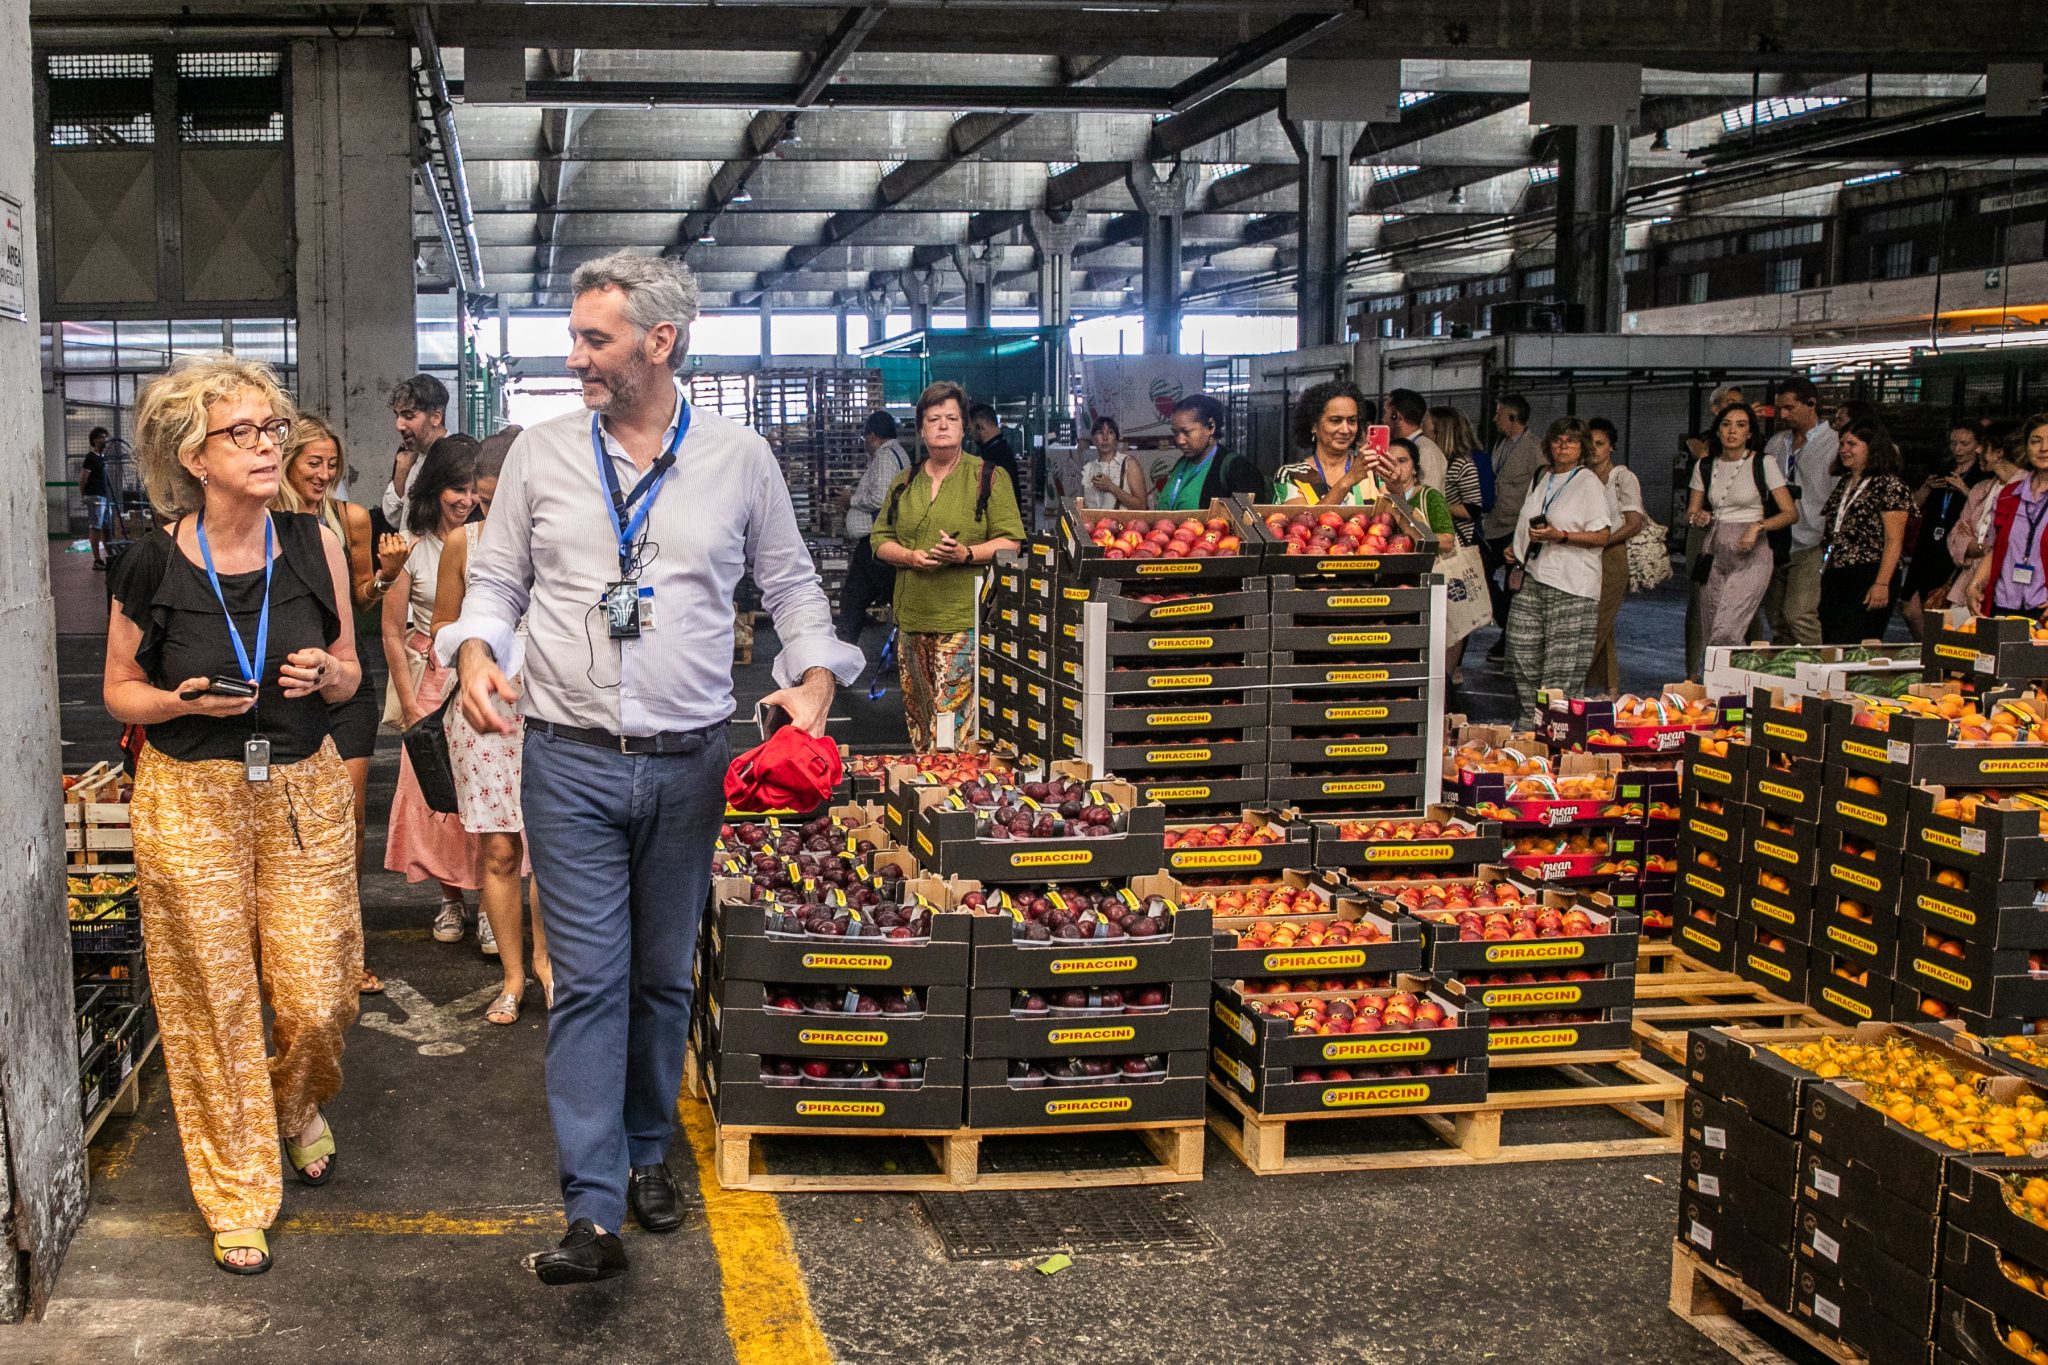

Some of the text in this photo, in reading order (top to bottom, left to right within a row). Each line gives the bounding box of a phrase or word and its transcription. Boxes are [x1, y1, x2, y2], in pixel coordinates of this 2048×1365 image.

[7, 244, 21, 268] AREA
[1159, 604, 1210, 614] PIRACCINI
[1158, 639, 1210, 647] PIRACCINI
[1940, 647, 1976, 658] PIRACCIN
[1157, 677, 1209, 685] PIRACCINI
[1335, 672, 1385, 680] PIRACCINI
[1335, 709, 1385, 717] PIRACCINI
[1156, 715, 1209, 723] PIRACCINI
[1658, 731, 1685, 740] mean
[1769, 726, 1805, 739] PIRACCINI
[1334, 746, 1385, 754] PIRACCINI
[1848, 744, 1888, 761] PIRACCIN
[1156, 752, 1208, 760] PIRACCINI
[1991, 761, 2048, 770] PIRACCIN
[1698, 767, 1730, 781] PIRACCINI
[1331, 783, 1382, 791] PIRACCINI
[1765, 784, 1802, 800] PIRACCINI
[1155, 789, 1207, 798] PIRACCINI
[1550, 806, 1578, 816] mean
[1843, 804, 1885, 823] PIRACCINI
[1694, 822, 1726, 839] PIRACCINI
[1377, 848, 1449, 858] PIRACCINI
[1760, 843, 1797, 861] PIRACCINI
[1022, 853, 1088, 863] PIRACCINI
[1184, 853, 1257, 864] PIRACCINI
[1543, 861, 1572, 871] mean
[1838, 868, 1879, 889] PIRACCINI
[1690, 877, 1723, 895] PIRACCINI
[1757, 902, 1793, 921] PIRACCINI
[1924, 900, 1973, 922] PIRACCINI
[1687, 930, 1719, 950] PIRACCINI
[1833, 930, 1875, 953] PIRACCINI
[1499, 946, 1579, 959] PIRACCINI
[815, 956, 888, 966] PIRACCINI
[1062, 959, 1133, 970] PIRACCINI
[1279, 954, 1361, 967] PIRACCINI
[1754, 959, 1789, 979] PIRACCINI
[1922, 963, 1969, 988] PIRACCINI
[1497, 990, 1576, 1003] PIRACCINI
[1830, 992, 1870, 1016] PIRACCINI
[811, 1033, 884, 1043] PIRACCINI
[1061, 1029, 1131, 1040] PIRACCINI
[1494, 1033, 1573, 1046] PIRACCINI
[1338, 1041, 1425, 1055] PIRACCINI
[1337, 1087, 1424, 1102] PIRACCINI
[809, 1104, 880, 1114] PIRACCINI
[1058, 1100, 1128, 1111] PIRACCINI
